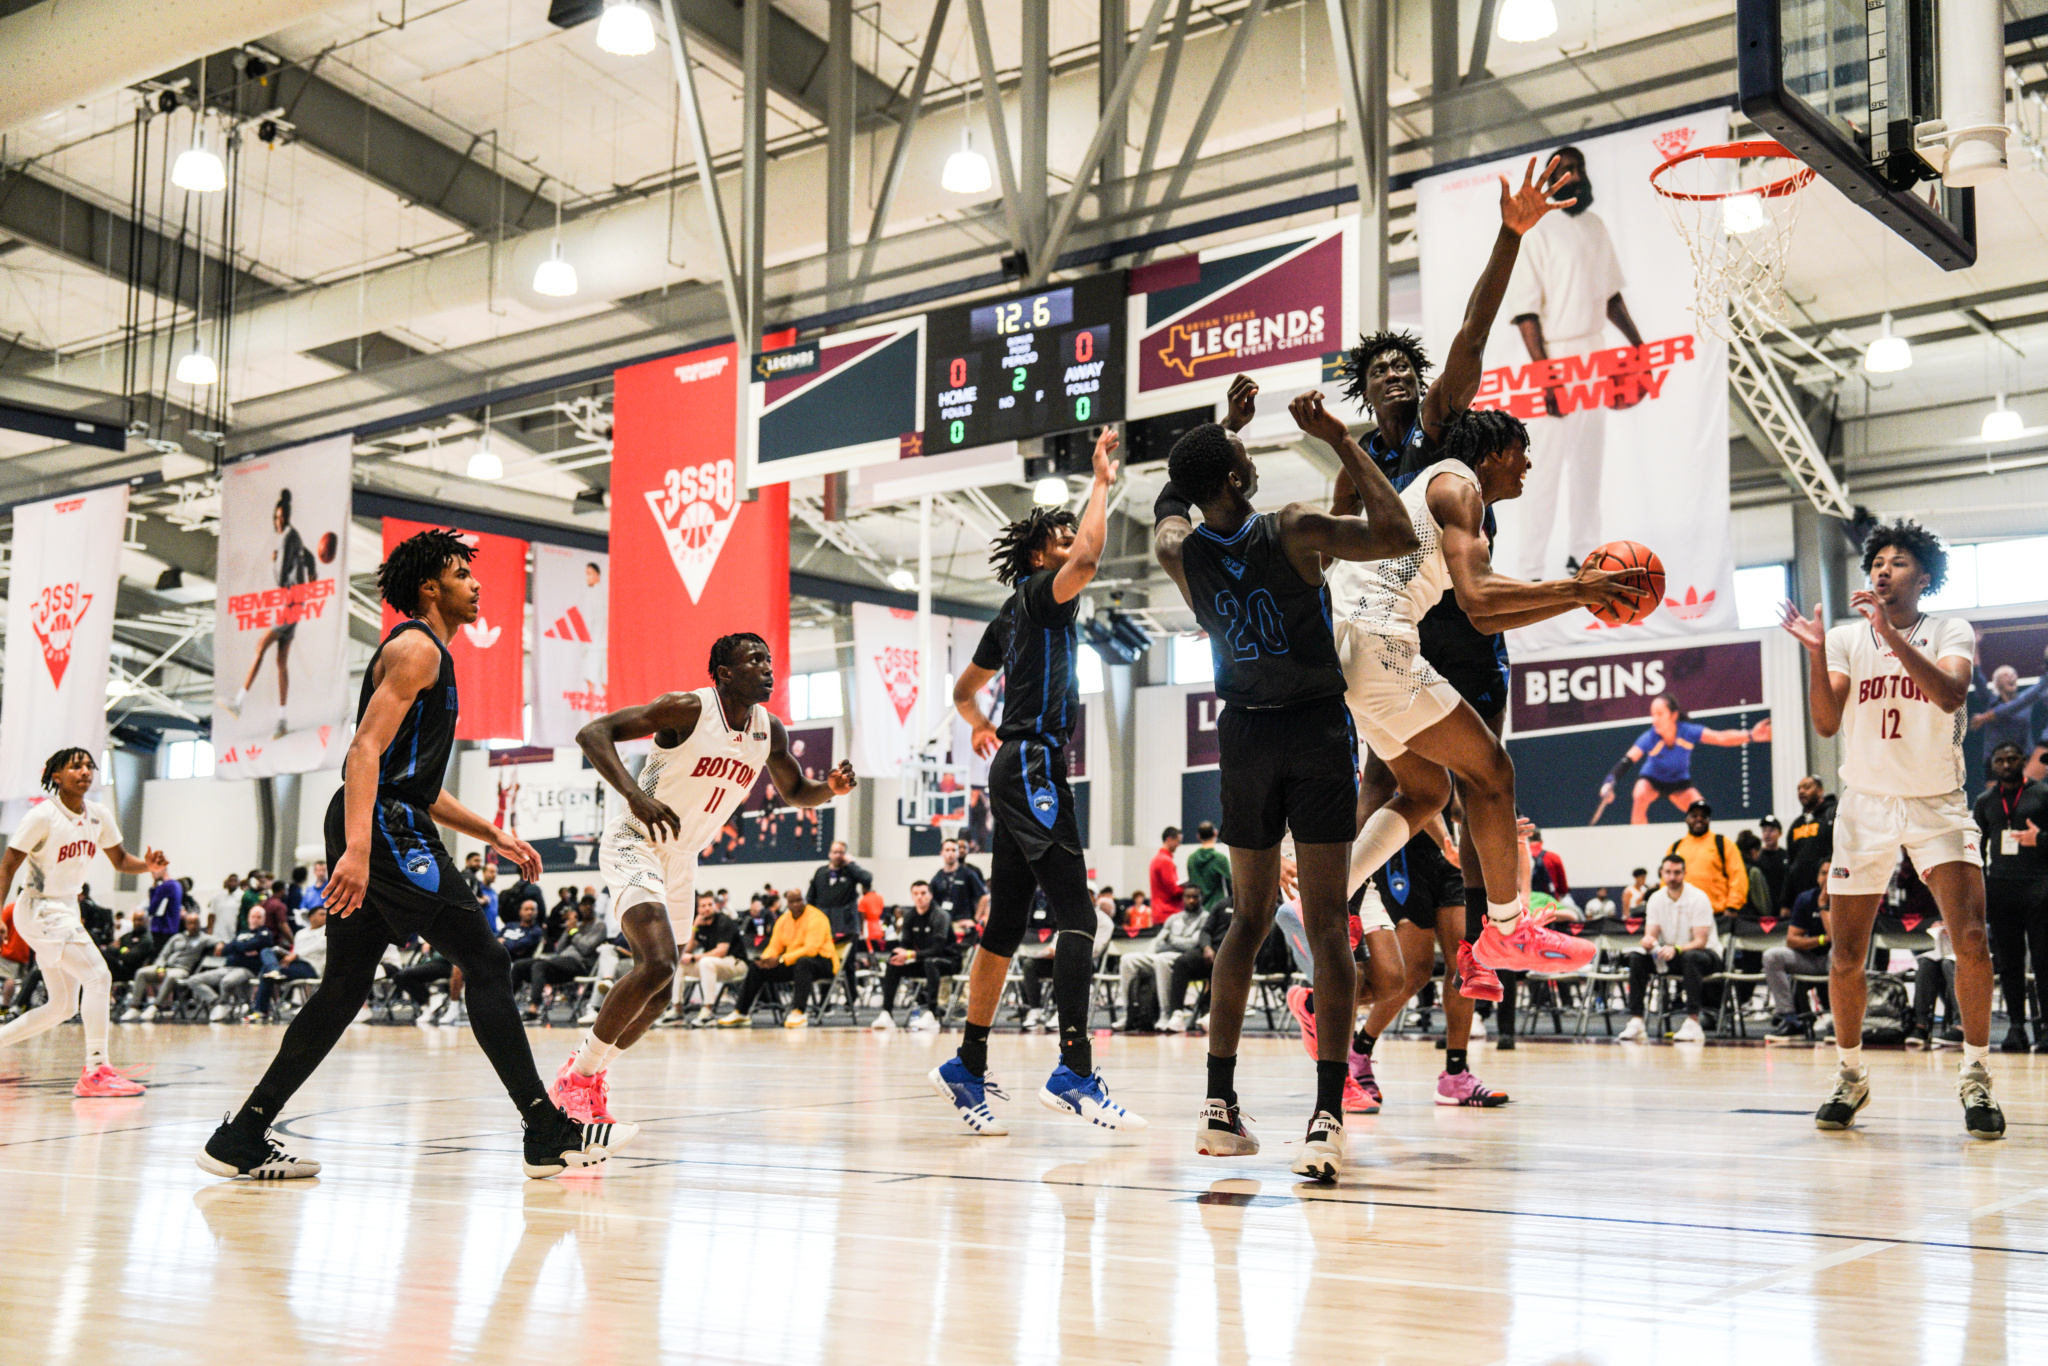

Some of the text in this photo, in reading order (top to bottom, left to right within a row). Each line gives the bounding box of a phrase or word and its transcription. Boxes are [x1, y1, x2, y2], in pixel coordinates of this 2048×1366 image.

[995, 296, 1051, 335] 12.6
[1223, 309, 1256, 324] TEXAS
[1190, 305, 1326, 358] LEGENDS
[1236, 331, 1325, 358] EVENT CENTER
[766, 350, 815, 371] LEGENDS
[1001, 351, 1039, 369] PERIOD
[1075, 331, 1094, 363] 0
[949, 357, 967, 388] 0
[1012, 367, 1027, 392] 2
[1063, 361, 1105, 384] AWAY
[1474, 334, 1696, 397] EMEMBER
[938, 386, 978, 407] HOME
[1065, 379, 1100, 396] FOULS
[1553, 369, 1670, 415] WHY
[941, 404, 973, 420] FOULS
[1075, 396, 1091, 421] 0
[949, 420, 965, 444] 0
[664, 458, 734, 522] 3SSB
[228, 578, 336, 615] REMEMBER
[236, 600, 327, 631] THE WHY
[1215, 588, 1290, 662] 20
[1525, 659, 1667, 706] BEGINS
[1881, 708, 1903, 740] 12
[690, 756, 757, 790] BOSTON
[703, 787, 727, 815] 11
[1199, 1108, 1225, 1119] DAME
[1318, 1120, 1342, 1136] TIME
